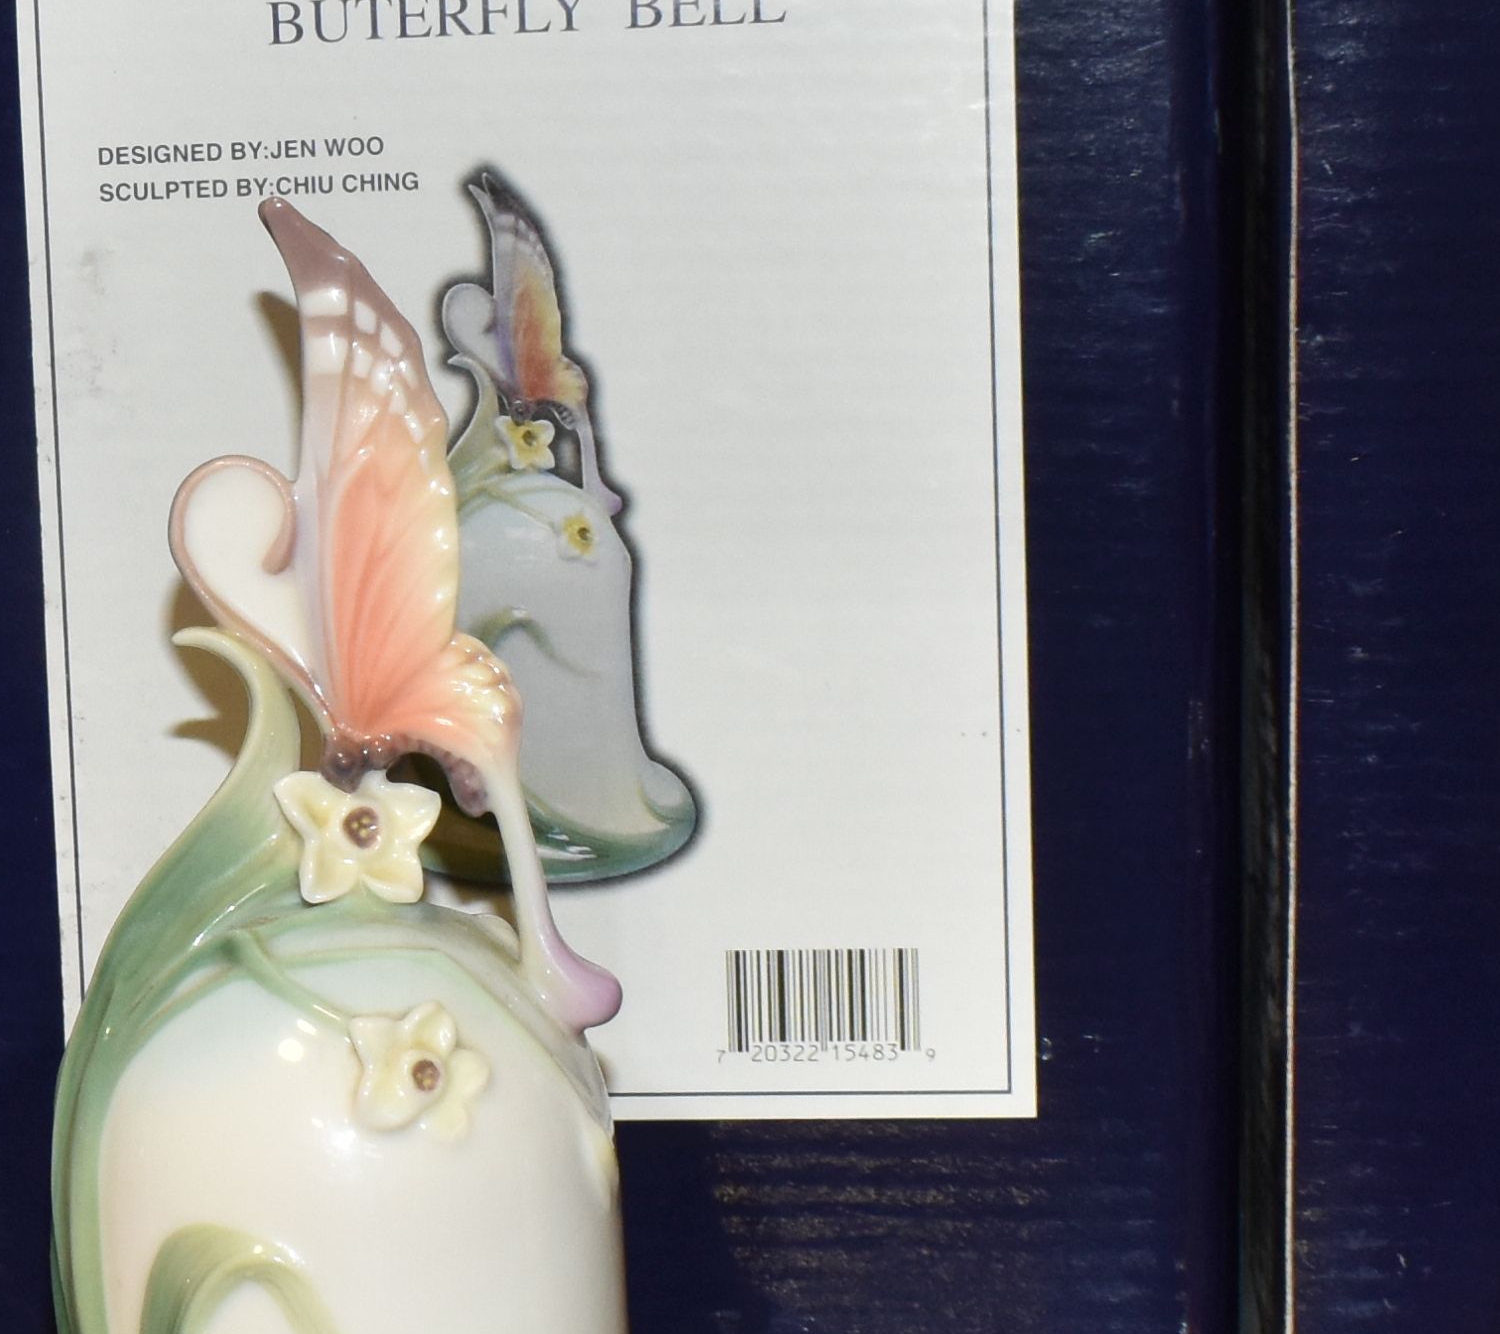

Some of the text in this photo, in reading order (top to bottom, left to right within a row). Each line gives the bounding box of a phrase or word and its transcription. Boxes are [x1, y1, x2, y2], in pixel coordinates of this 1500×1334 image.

[98, 142, 222, 166] DESIGNED
[324, 136, 384, 157] WOO
[99, 179, 228, 202] SCULPTED
[342, 171, 419, 194] CHING
[750, 1044, 819, 1062] 20322
[831, 1043, 899, 1062] 15483
